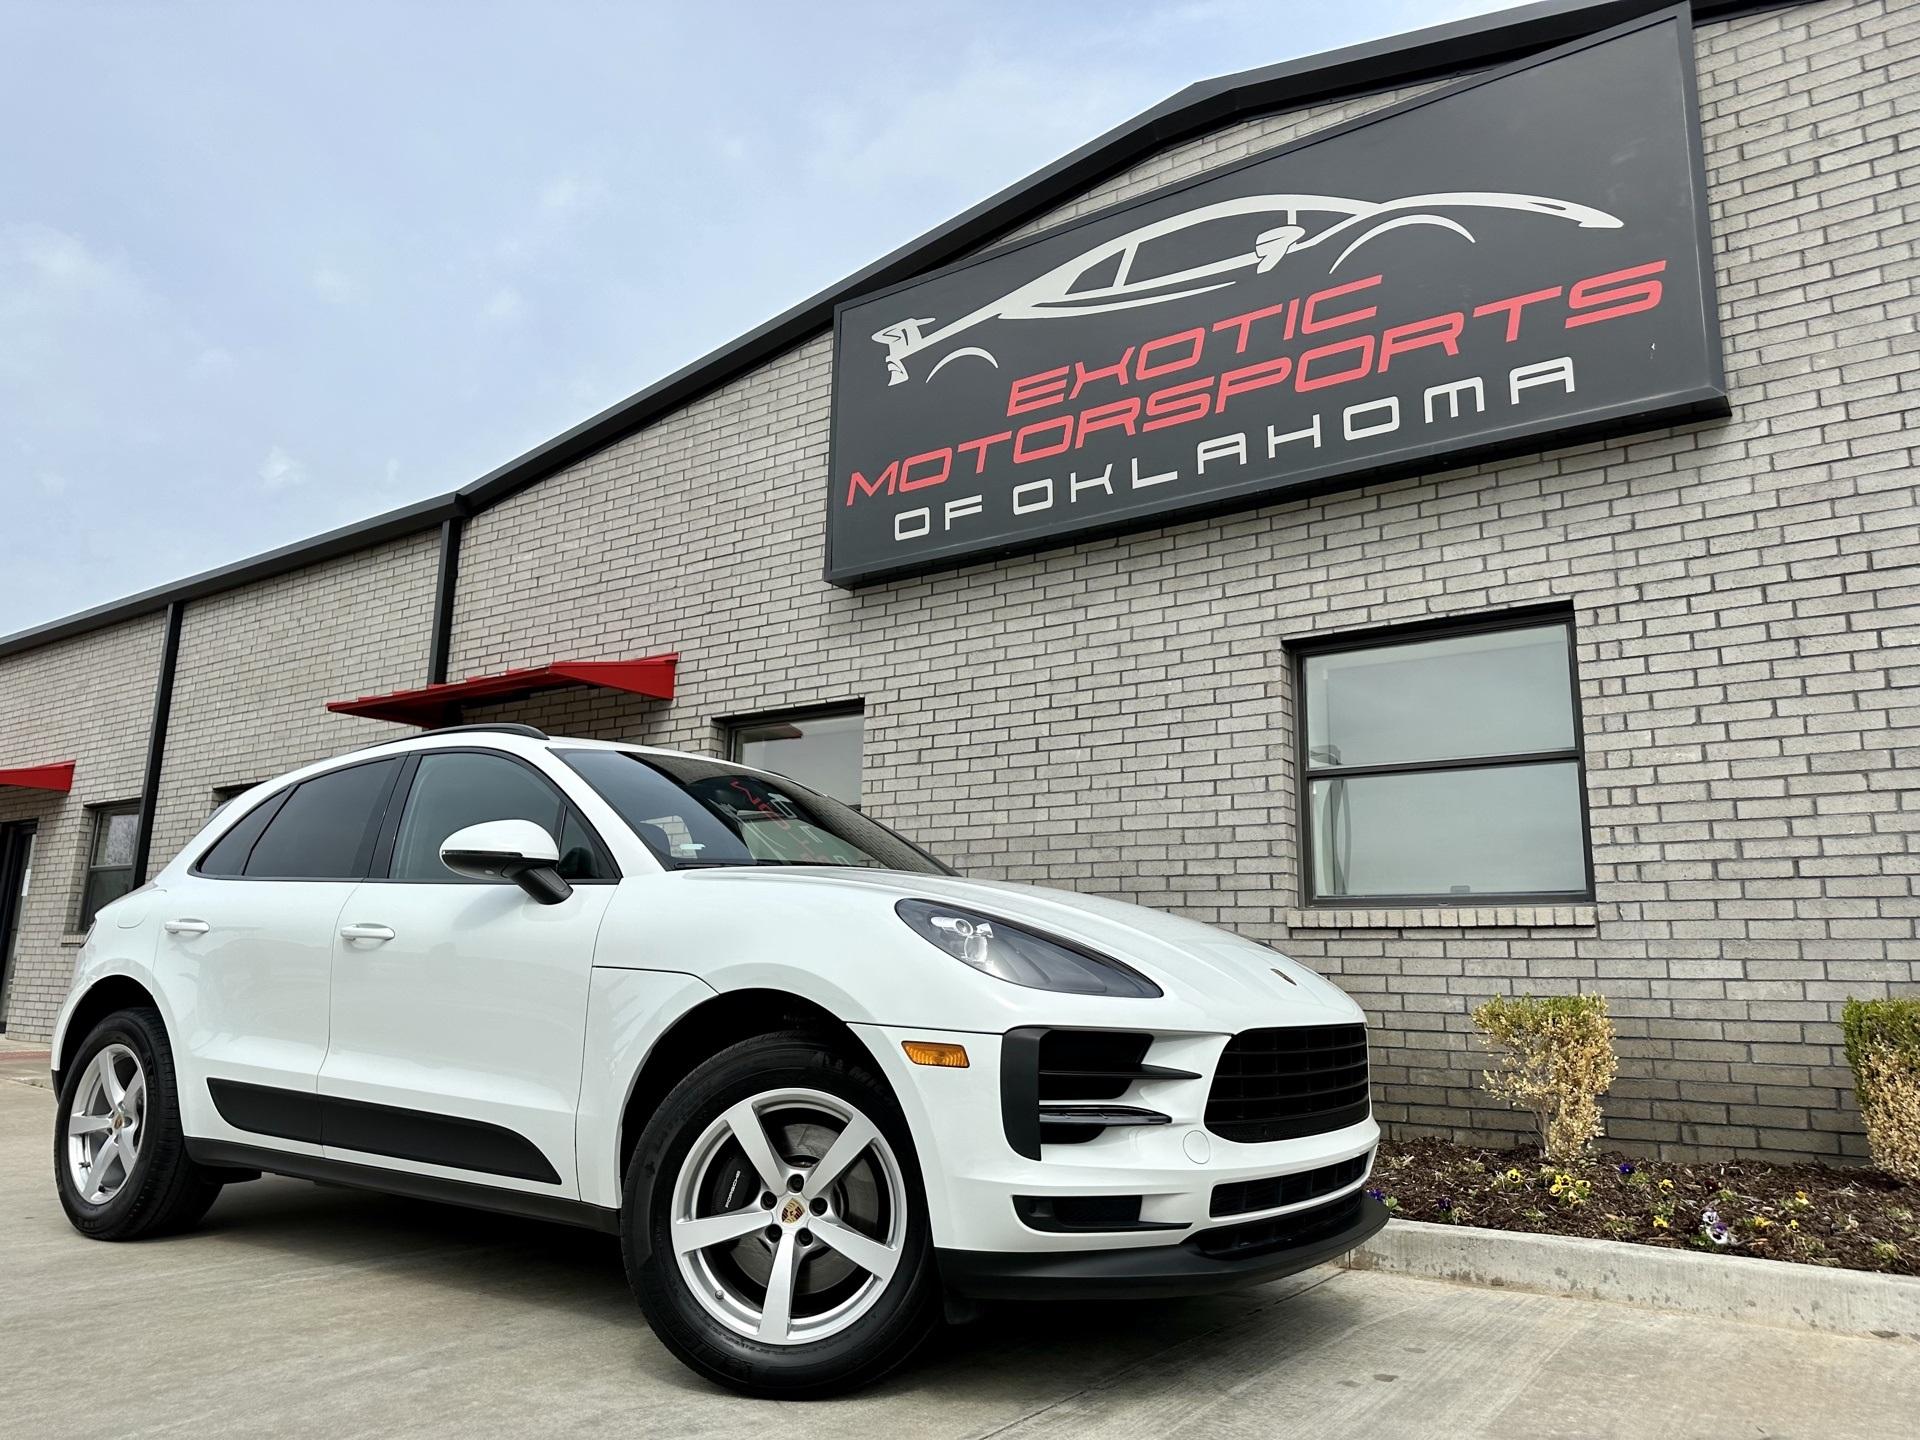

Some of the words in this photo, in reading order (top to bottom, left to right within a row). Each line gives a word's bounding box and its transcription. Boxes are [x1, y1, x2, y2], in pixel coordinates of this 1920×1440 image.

[847, 261, 1665, 505] MOTORSPORTS
[1007, 275, 1381, 417] EXOTIC
[894, 494, 983, 541] OF
[1012, 356, 1576, 516] OKLAHOMA
